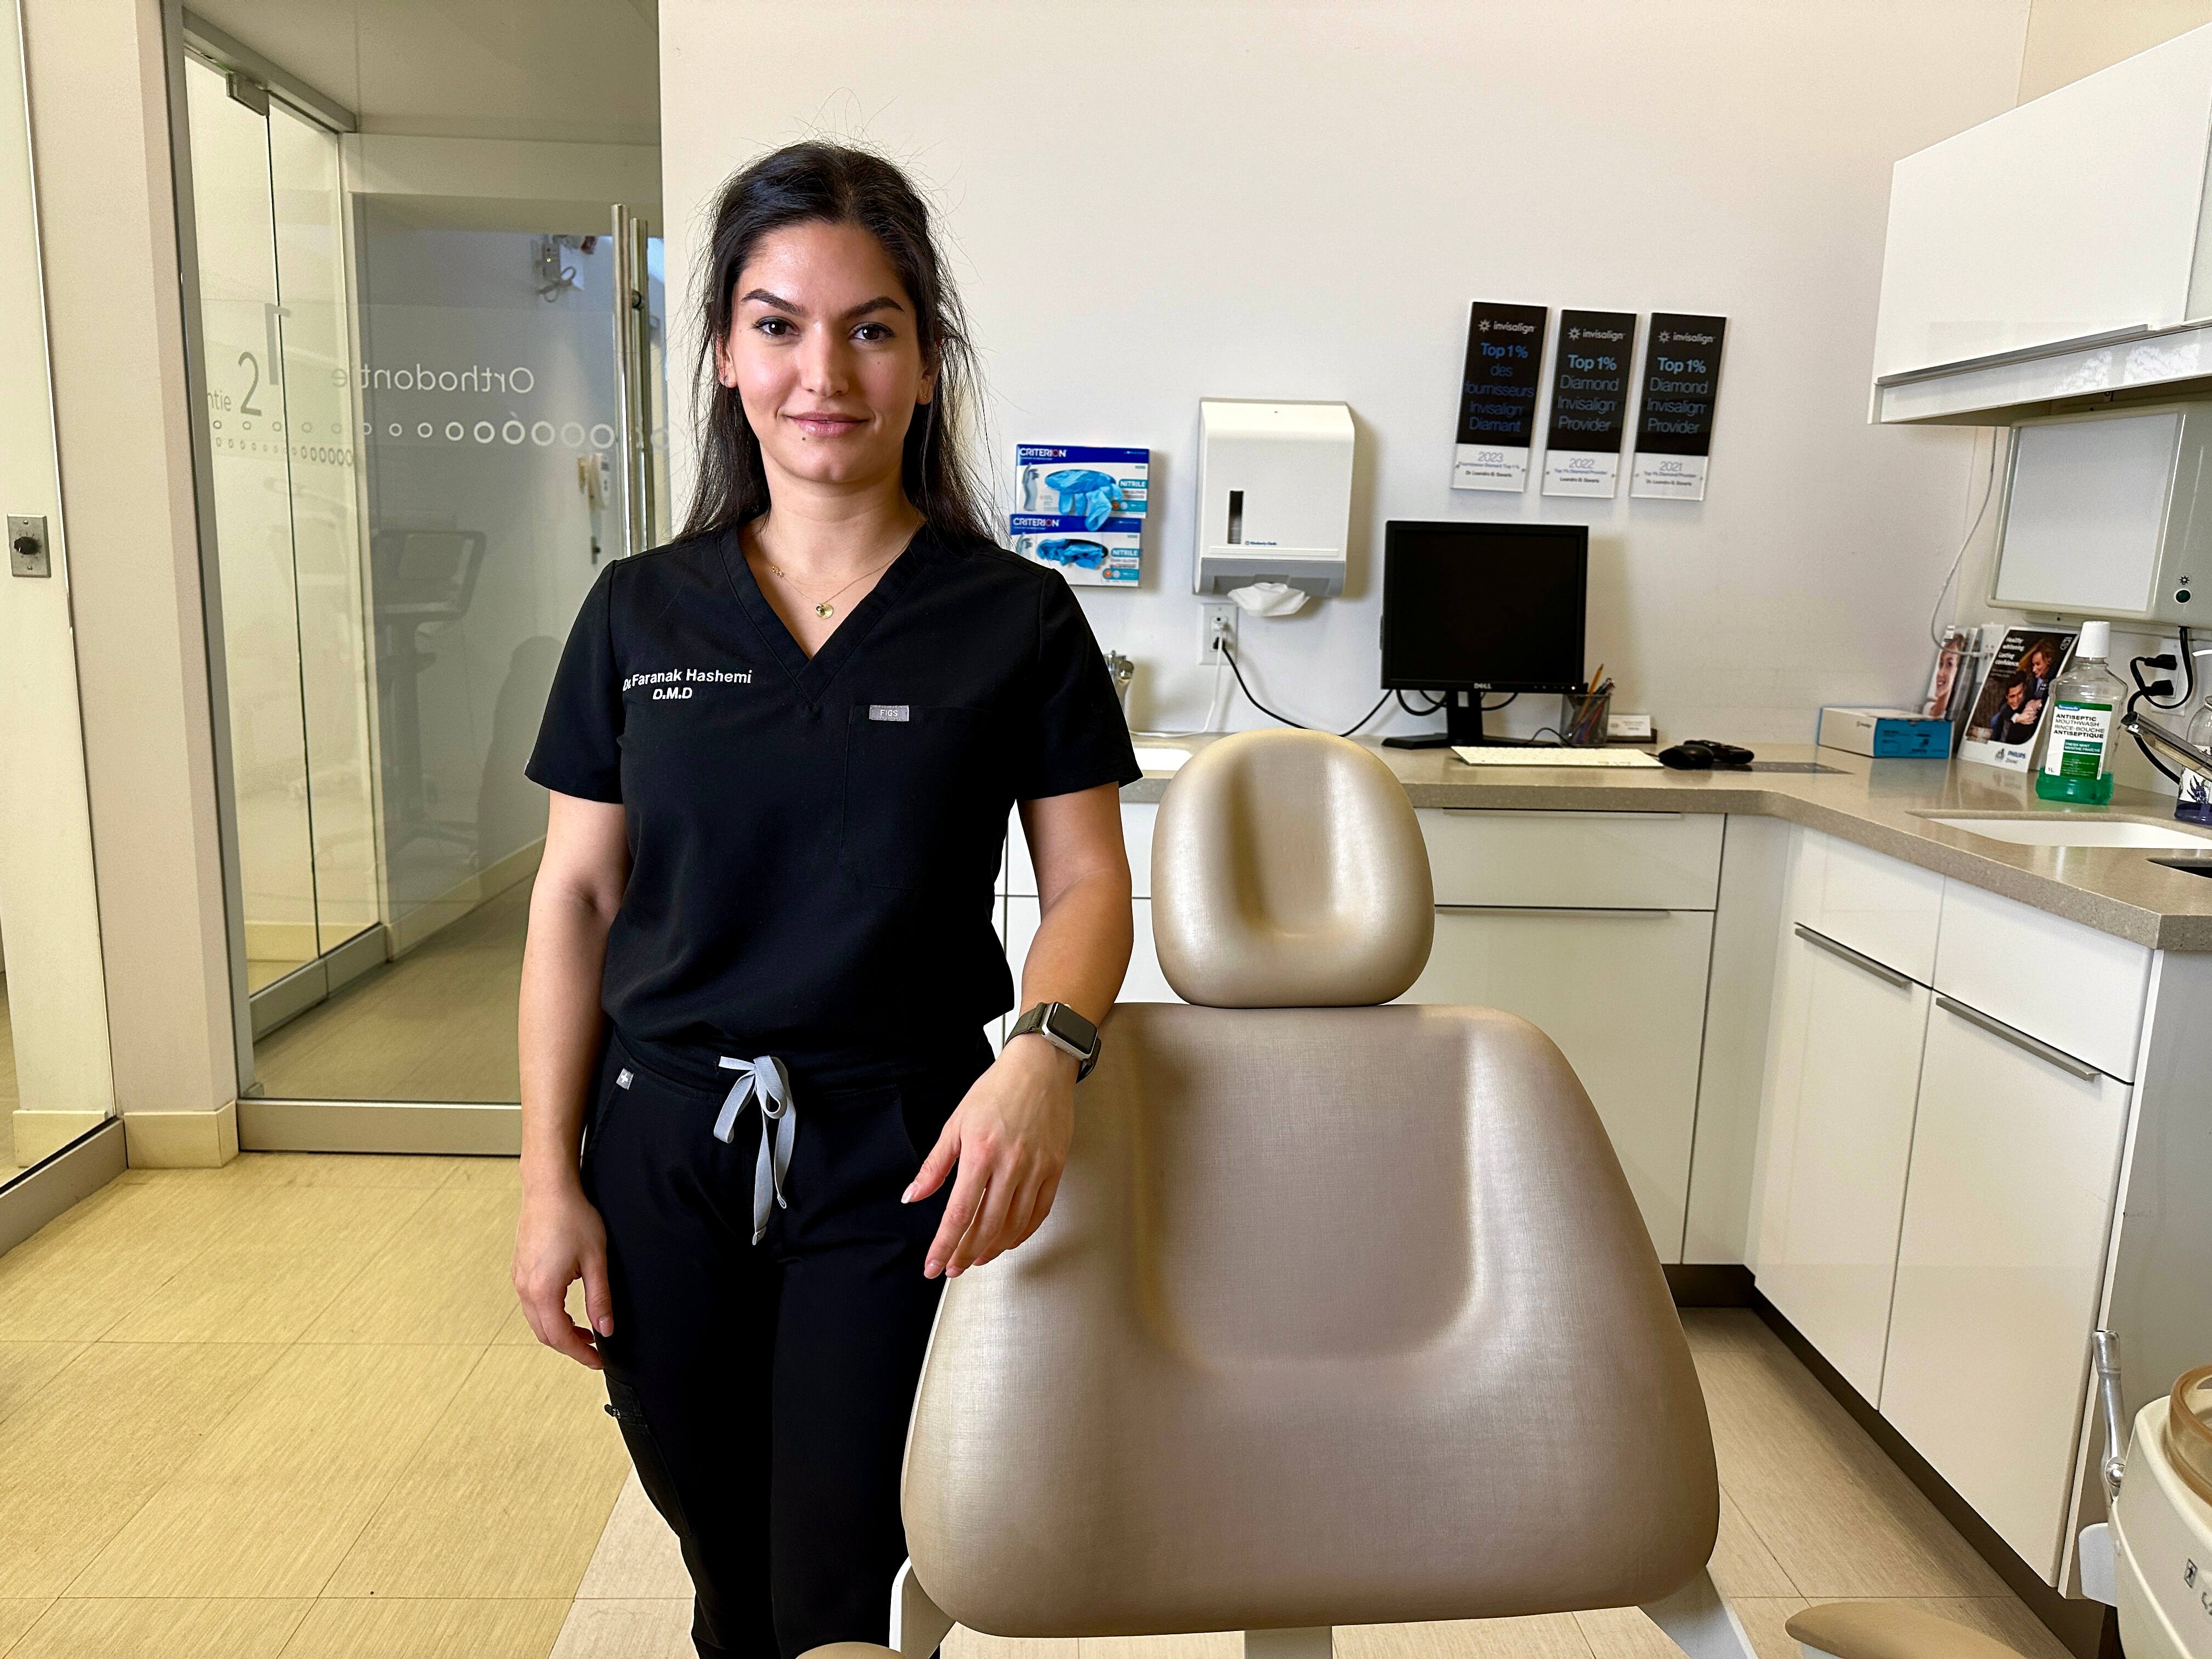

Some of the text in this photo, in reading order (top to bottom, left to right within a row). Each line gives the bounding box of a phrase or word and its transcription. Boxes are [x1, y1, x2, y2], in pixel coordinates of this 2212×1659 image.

[1493, 320, 1534, 334] invisalign
[1582, 329, 1624, 341] invisalign
[1672, 332, 1713, 345] invisalign
[1480, 342, 1505, 359] Top
[1567, 354, 1617, 371] Top 1%
[1657, 357, 1706, 374] Top 1%
[1489, 363, 1513, 377] des
[238, 351, 262, 416] 2
[1464, 380, 1534, 398] fournisseurs
[1560, 375, 1620, 391] Diamond
[1650, 377, 1709, 394] Diamond
[1469, 416, 1521, 432] Diamant
[1558, 415, 1611, 432] Provider
[1647, 417, 1700, 434] Provider
[1019, 447, 1066, 458] CRITERION
[1478, 452, 1503, 462] 2023
[1569, 458, 1595, 469] 2022
[1659, 461, 1683, 472] 2021
[1013, 517, 1059, 527] CRITERION
[632, 669, 682, 686] Faranak
[686, 669, 752, 684] Hashemi
[653, 687, 692, 700] D.M.D
[2053, 730, 2104, 738] ANTISEPTIQUE
[2054, 724, 2105, 733] RINCE-BOUCHE
